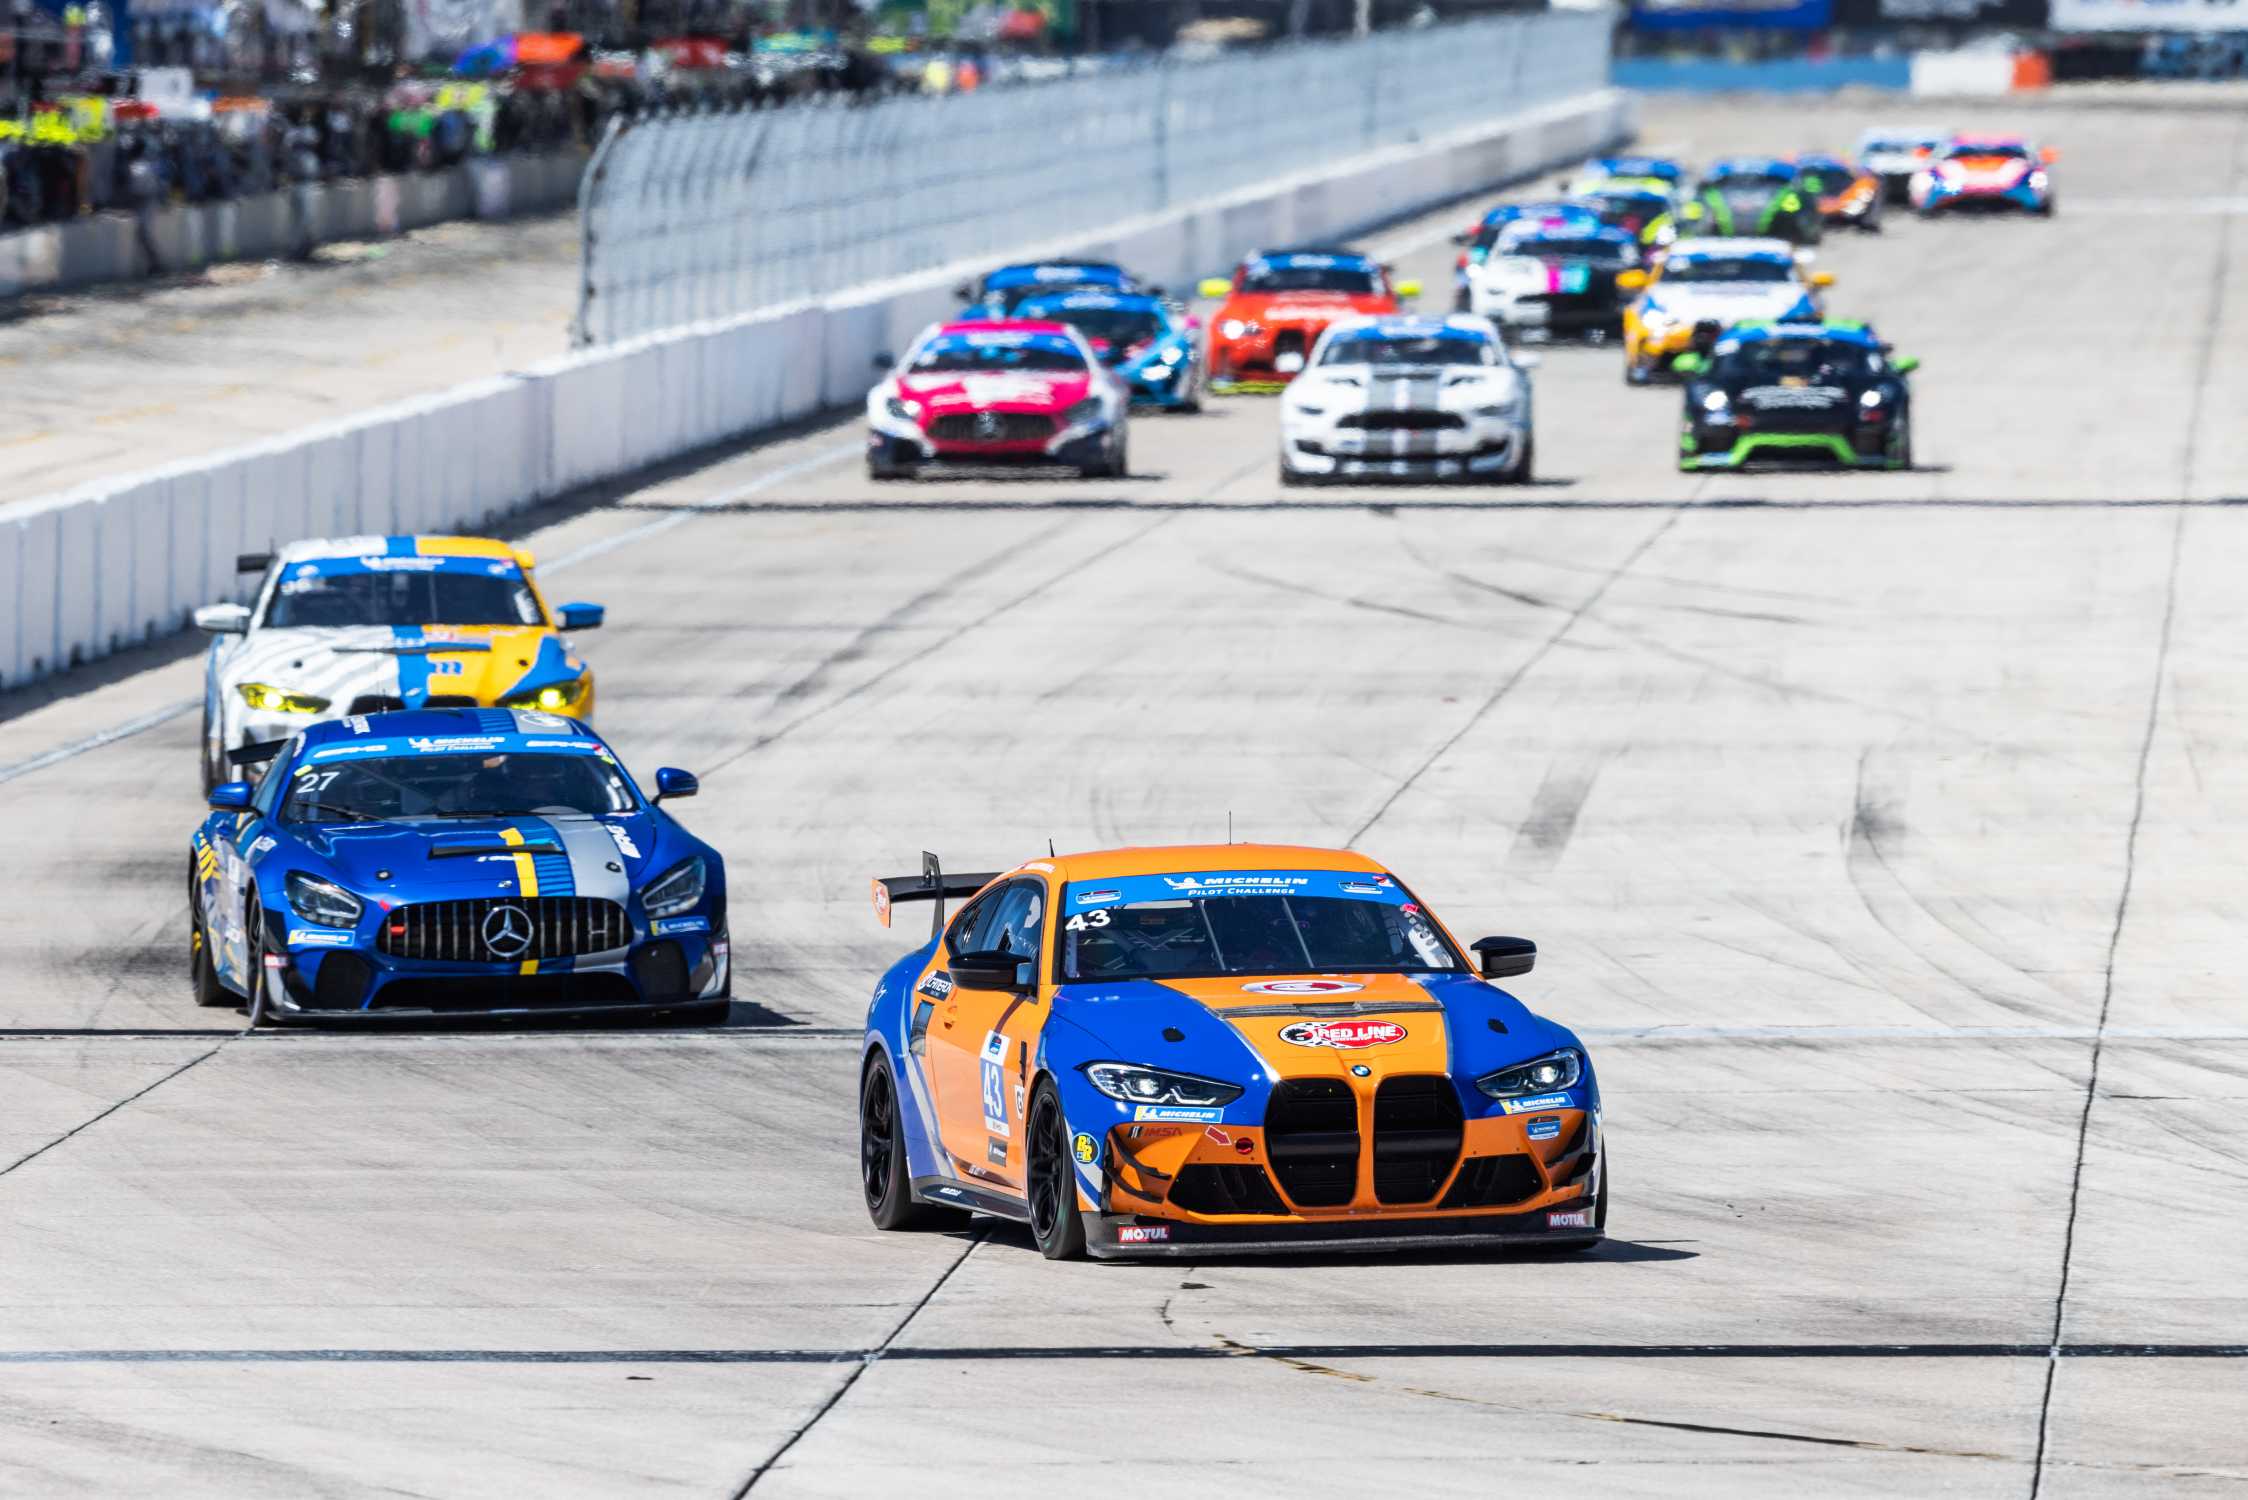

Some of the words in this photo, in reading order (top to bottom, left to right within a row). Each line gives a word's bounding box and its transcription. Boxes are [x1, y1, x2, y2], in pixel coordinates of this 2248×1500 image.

[296, 771, 340, 793] 27
[1204, 877, 1309, 885] MICHELIN
[1065, 909, 1111, 931] 43
[1318, 1027, 1353, 1040] RED
[1357, 1025, 1396, 1039] LINE
[983, 1062, 1003, 1118] 43
[1523, 1097, 1566, 1106] MICHELIN
[1159, 1110, 1216, 1119] MICHELIN
[1143, 1127, 1183, 1137] IMSA
[1550, 1213, 1585, 1226] MOTUL
[1121, 1228, 1168, 1240] MOTUL
